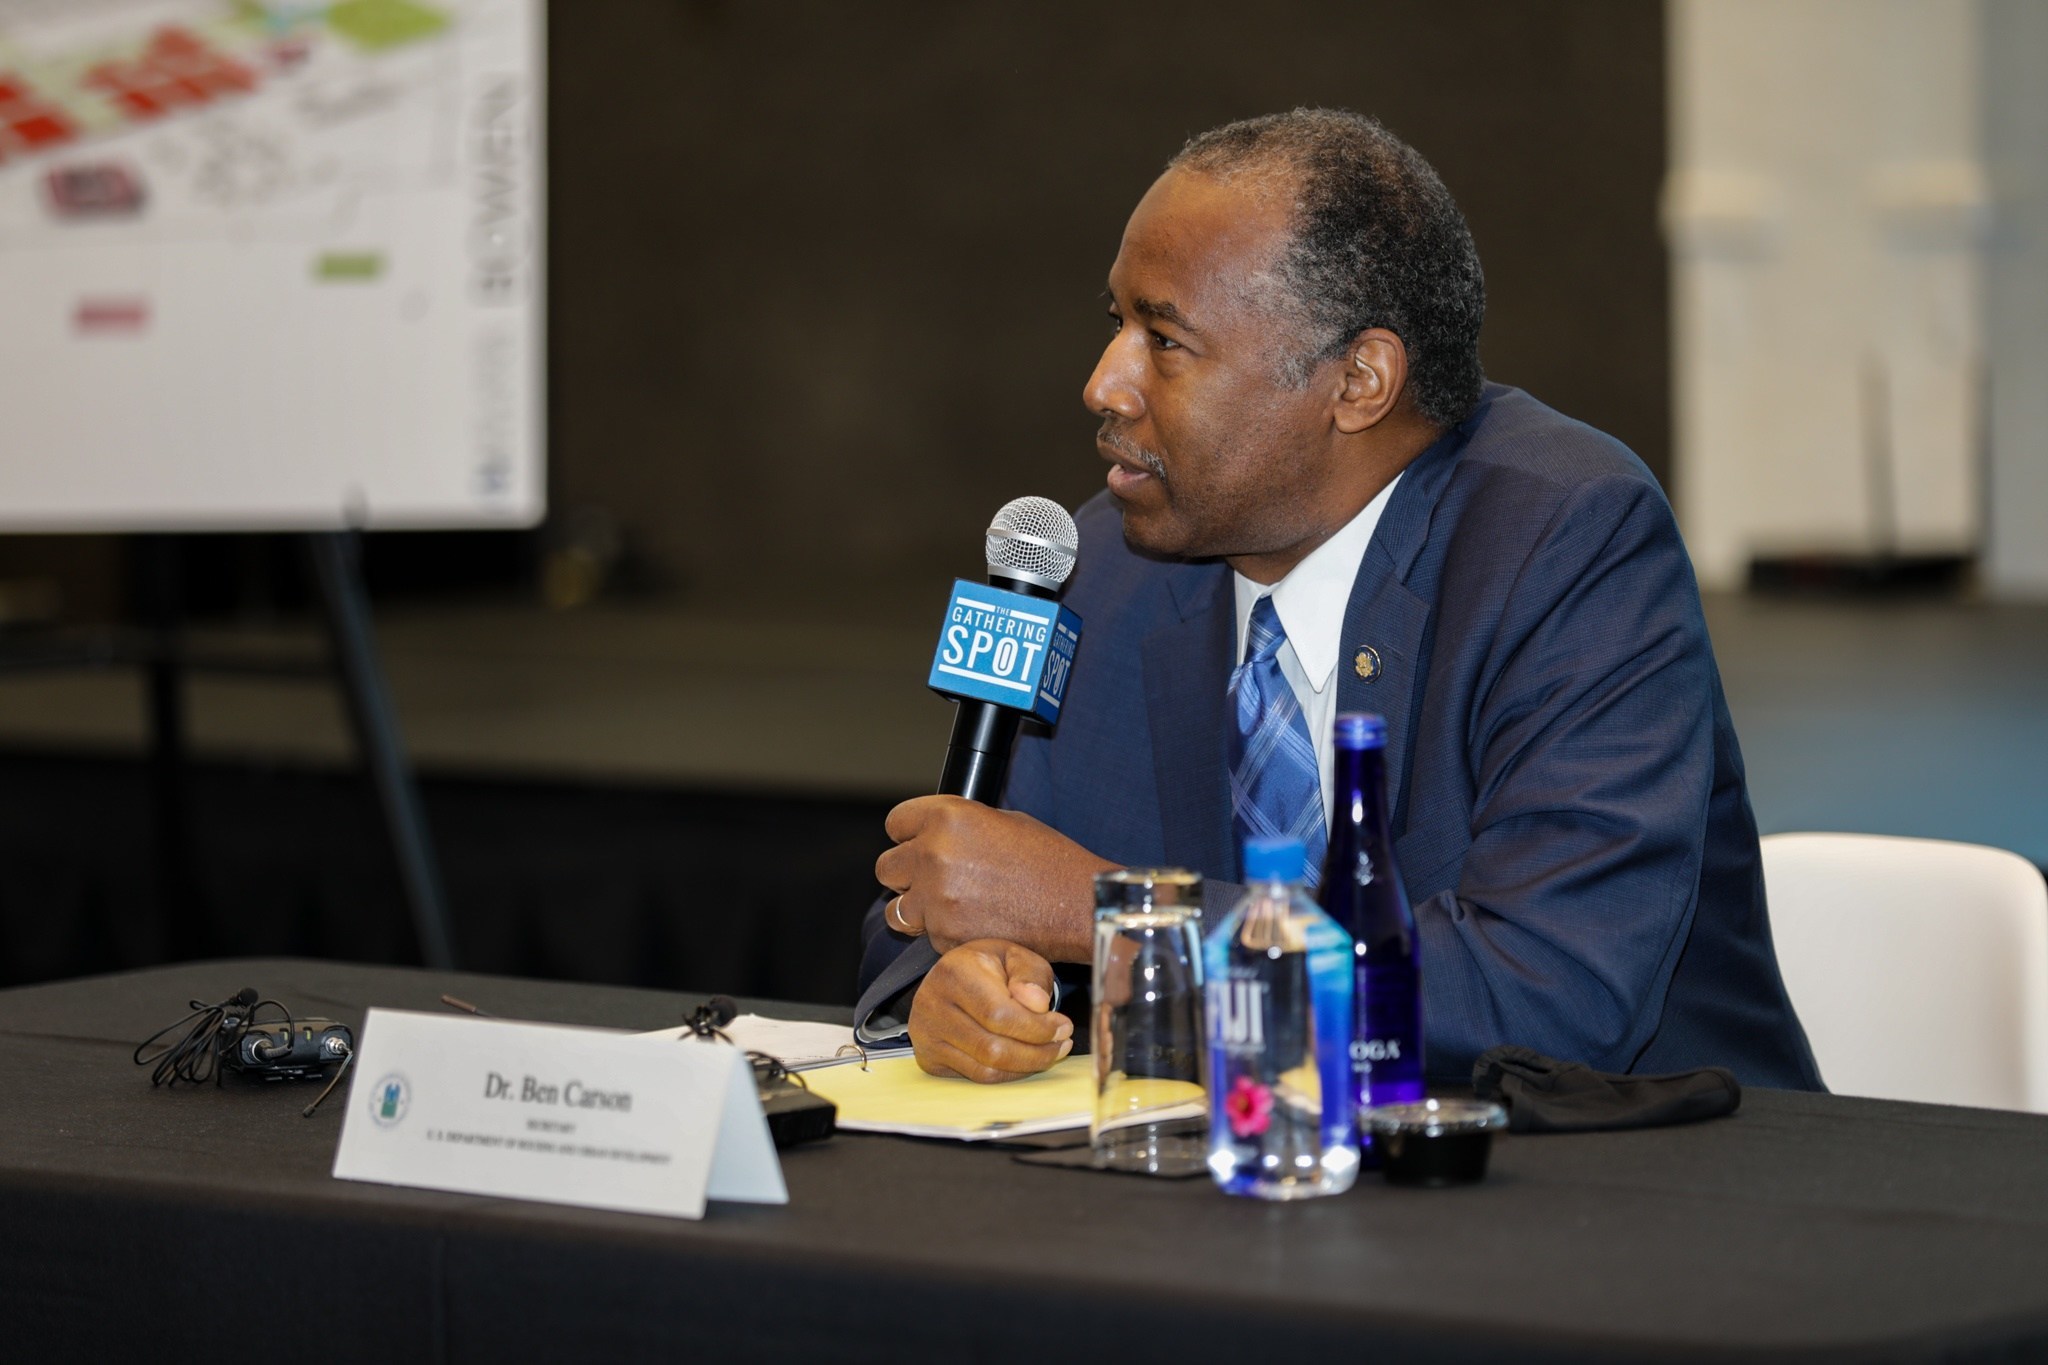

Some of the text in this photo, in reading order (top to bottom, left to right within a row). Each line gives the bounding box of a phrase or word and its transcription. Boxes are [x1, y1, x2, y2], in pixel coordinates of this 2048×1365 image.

[952, 607, 1047, 642] GATHERING
[996, 606, 1010, 616] THE
[942, 625, 1043, 681] SPOT
[1043, 650, 1071, 698] SPOT
[484, 1071, 632, 1112] Dr. Ben Carson
